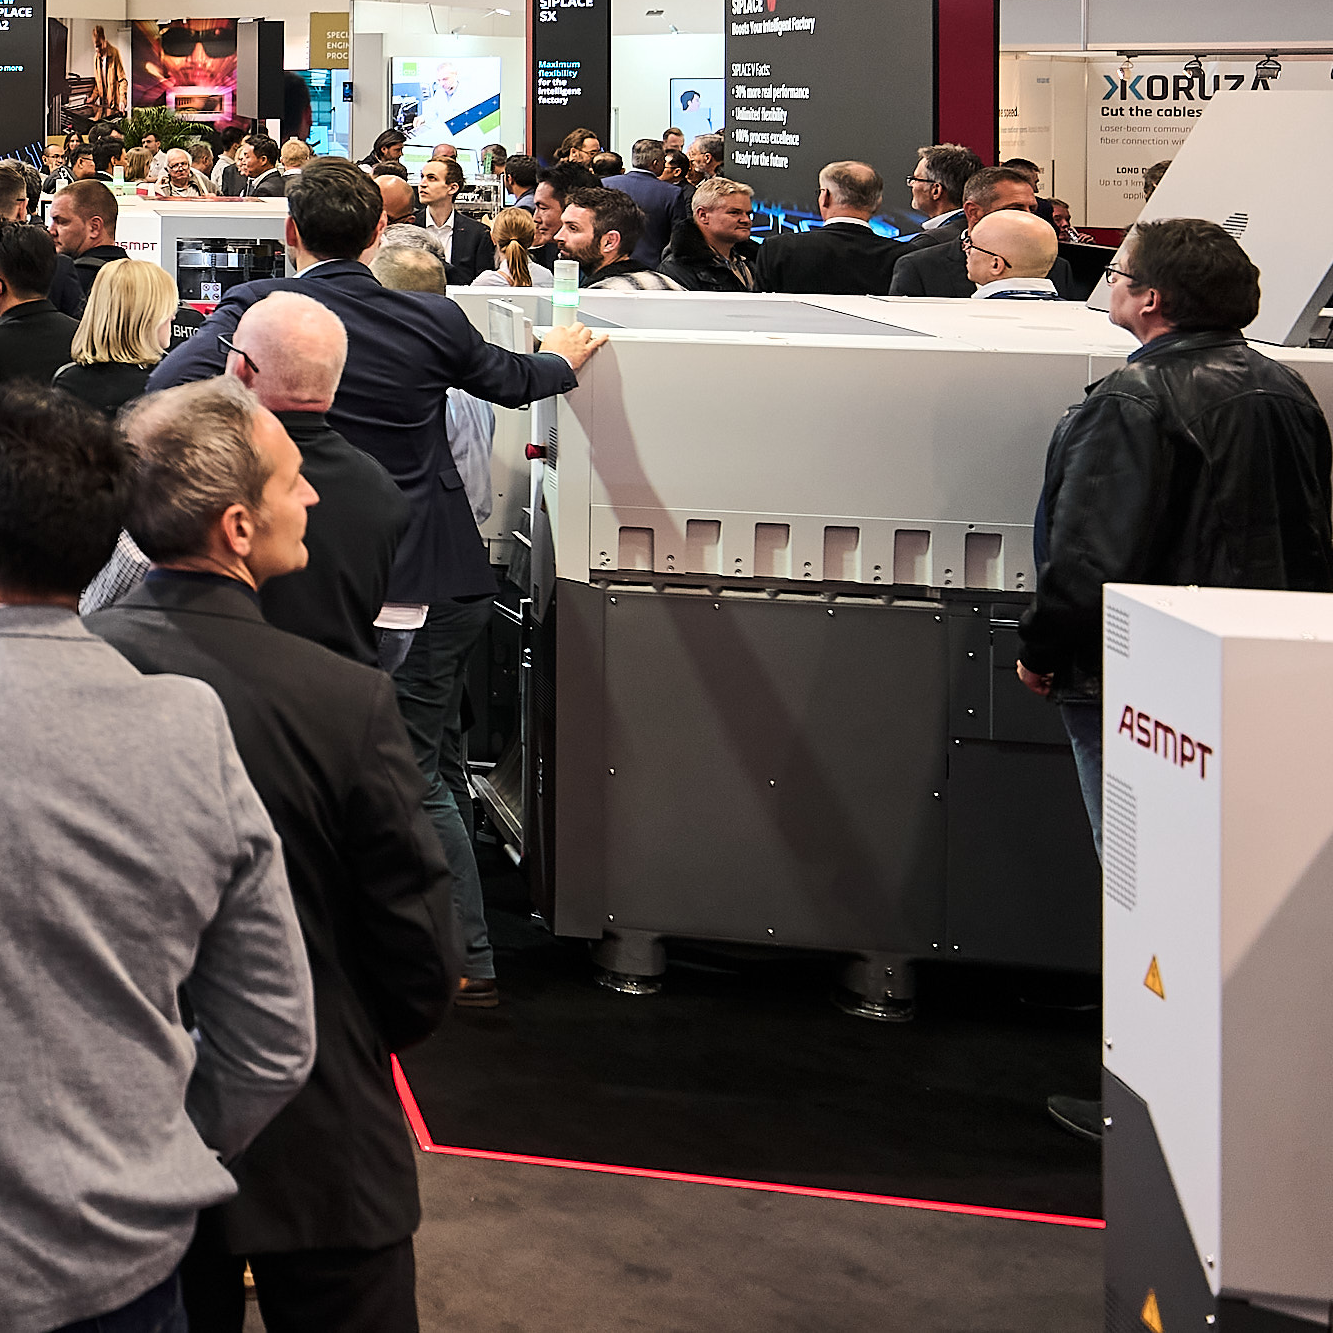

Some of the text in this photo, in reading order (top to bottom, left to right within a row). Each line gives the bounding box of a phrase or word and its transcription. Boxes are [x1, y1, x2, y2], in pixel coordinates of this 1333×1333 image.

[539, 10, 558, 22] SX
[791, 16, 816, 35] Factory
[538, 60, 581, 68] Maximum
[538, 69, 579, 78] flexibility
[538, 78, 568, 86] for the
[538, 87, 582, 97] intelligent
[746, 87, 761, 99] more
[772, 83, 810, 103] performance
[538, 96, 569, 105] factory
[1101, 106, 1203, 117] Cut the cables
[1100, 124, 1151, 133] Laser-beam
[1100, 137, 1169, 146] fiber connection
[1116, 166, 1139, 174] LONG
[1099, 179, 1110, 187] Up
[1118, 704, 1213, 781] ASMPT
